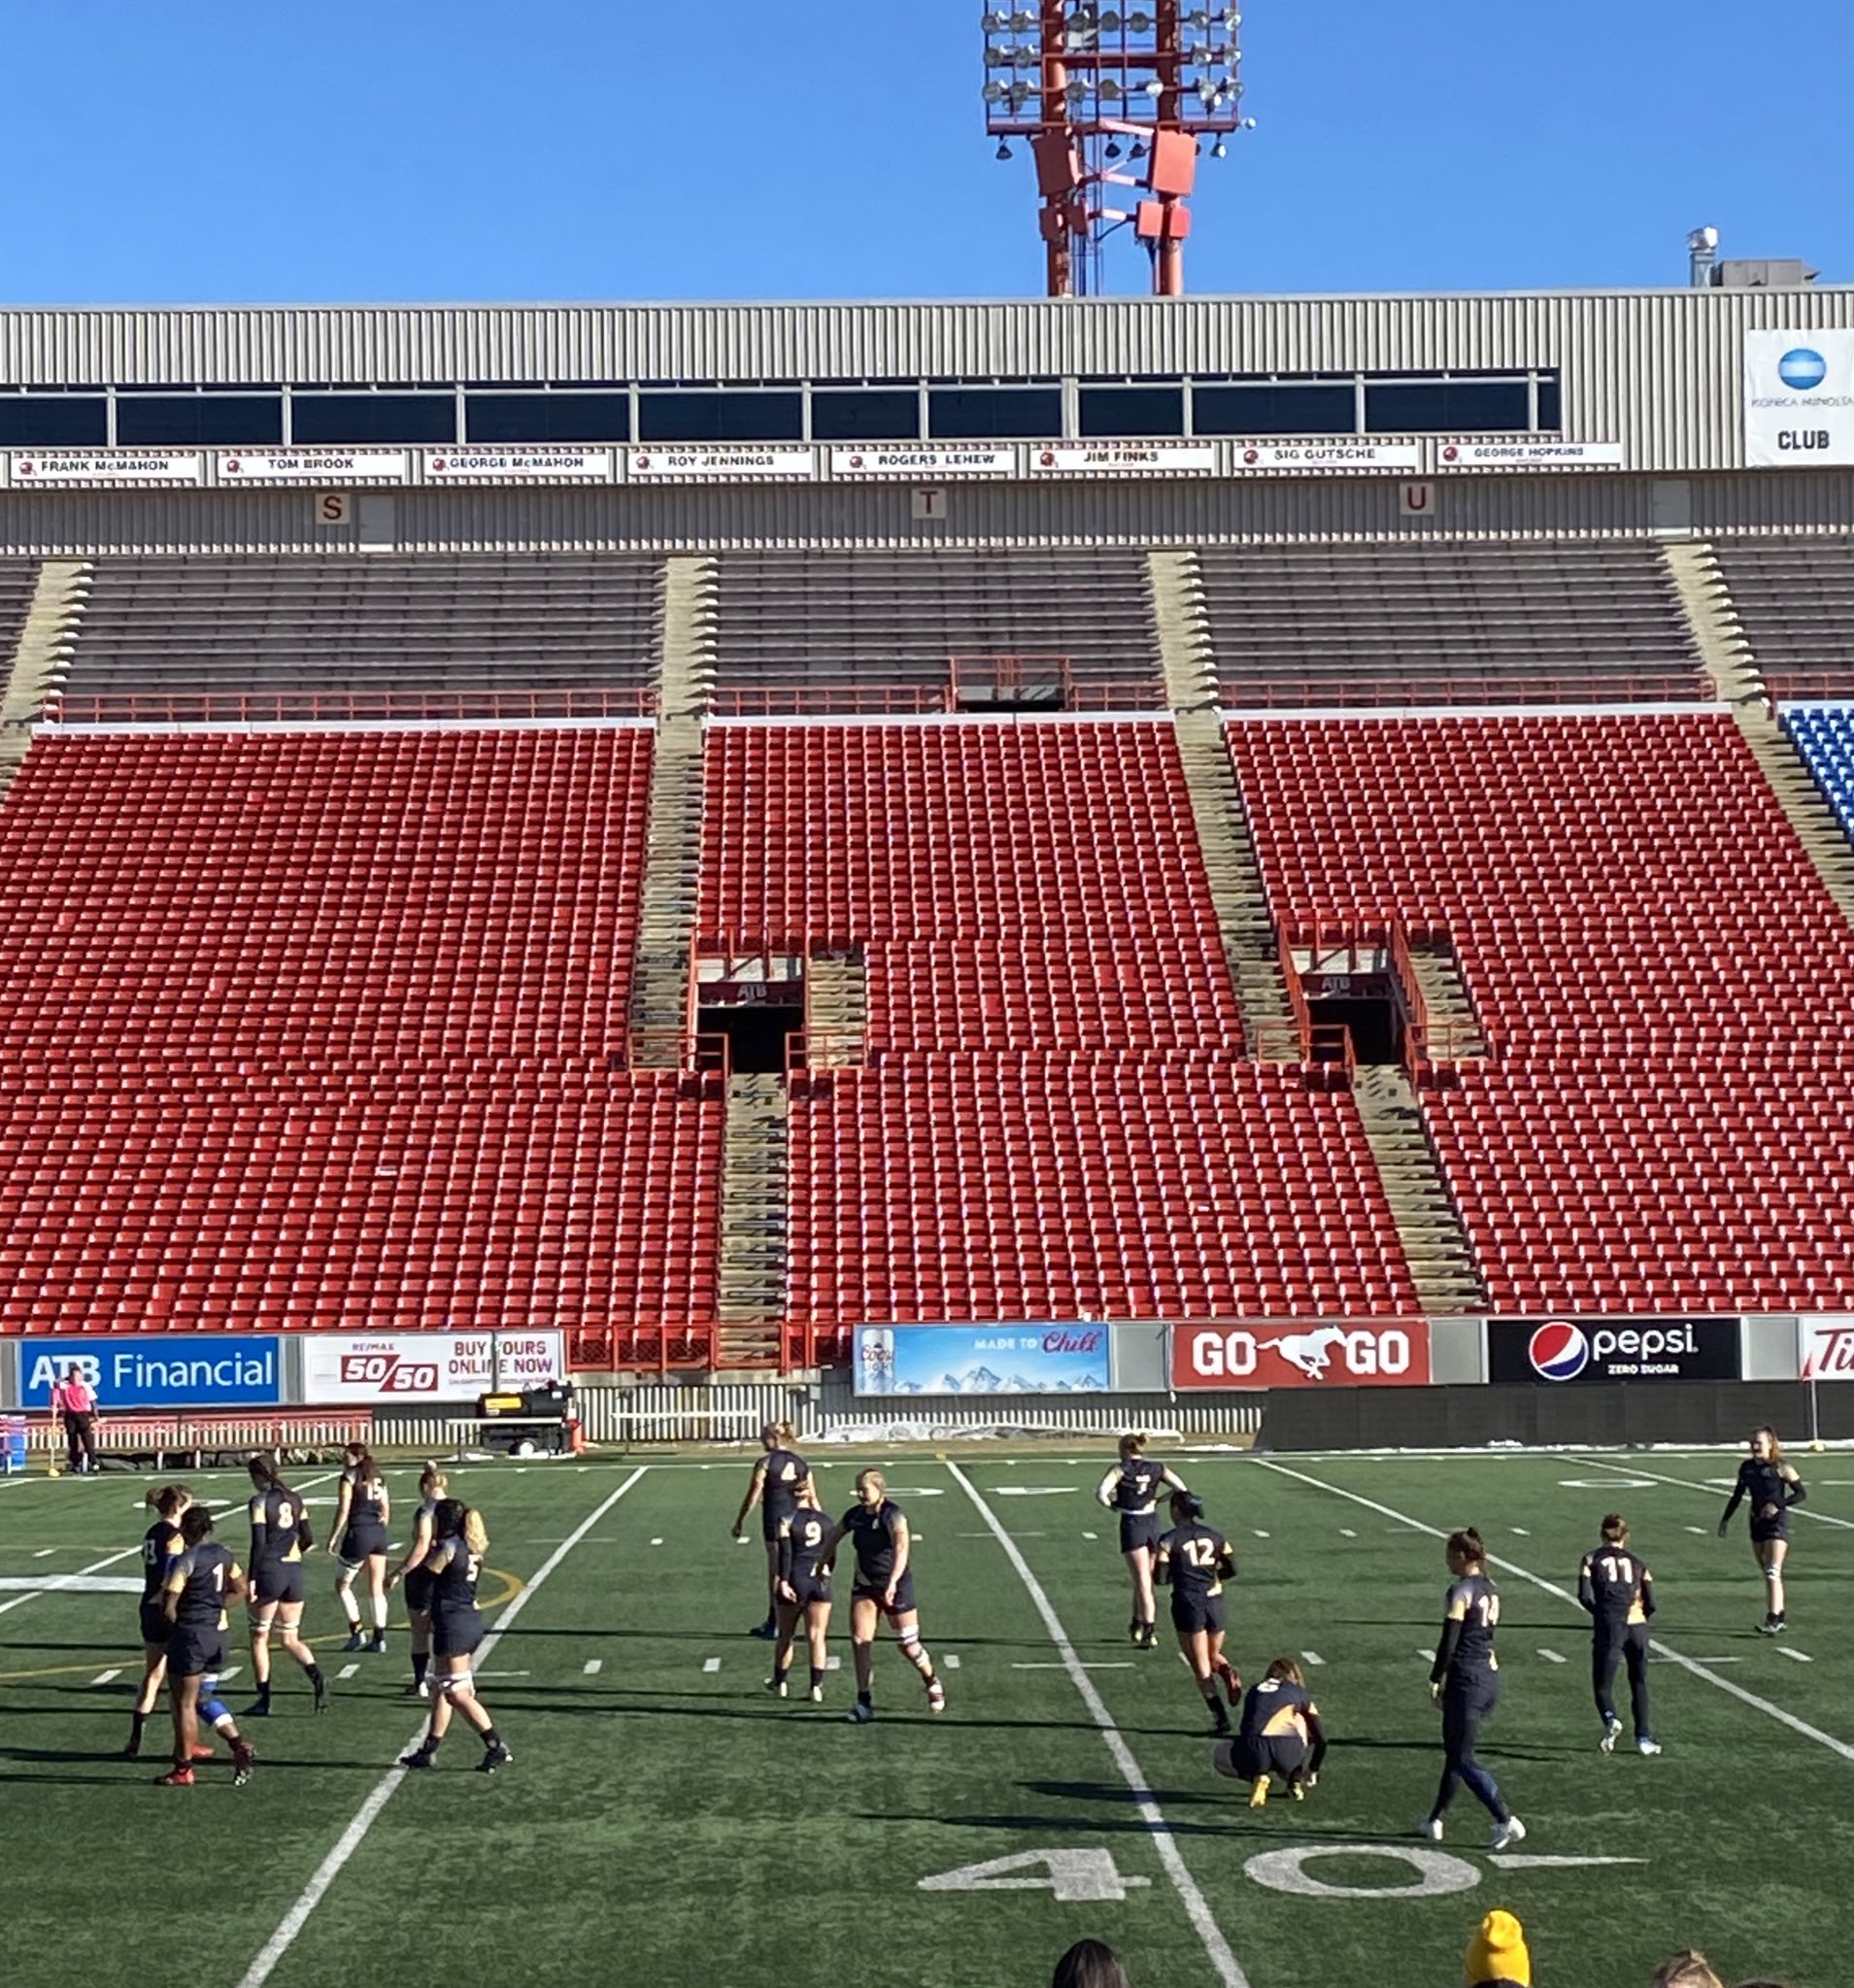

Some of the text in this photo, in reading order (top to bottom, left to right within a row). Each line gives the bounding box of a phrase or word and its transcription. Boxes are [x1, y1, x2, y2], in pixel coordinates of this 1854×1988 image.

[1777, 430, 1830, 449] CLUB
[668, 455, 774, 466] ROY JENNINGS
[878, 455, 937, 466] ROGERS
[1083, 451, 1159, 462] JIM FINKS
[1274, 448, 1375, 460] SIG GUTSCHE
[1474, 448, 1525, 457] GEORGE
[41, 460, 89, 472] FRANK
[268, 459, 354, 470] TOM BROOK
[450, 457, 506, 468] GEORGE
[322, 495, 343, 521] S
[919, 490, 938, 515] T
[1406, 487, 1427, 511] U
[455, 1341, 486, 1357] BUY
[974, 1331, 1102, 1353] MADE TO Chill
[1594, 1324, 1694, 1361] pepsi
[1193, 1331, 1409, 1376] GO GO
[114, 1351, 272, 1389] Financial
[515, 1359, 553, 1373] NOW
[1608, 1364, 1679, 1375] ZERO SUGAR
[781, 1462, 796, 1481] 4
[278, 1501, 293, 1529] 8
[804, 1521, 822, 1547] 9
[1182, 1537, 1216, 1567] 12
[212, 1562, 224, 1593] 1
[1600, 1556, 1634, 1584] 11
